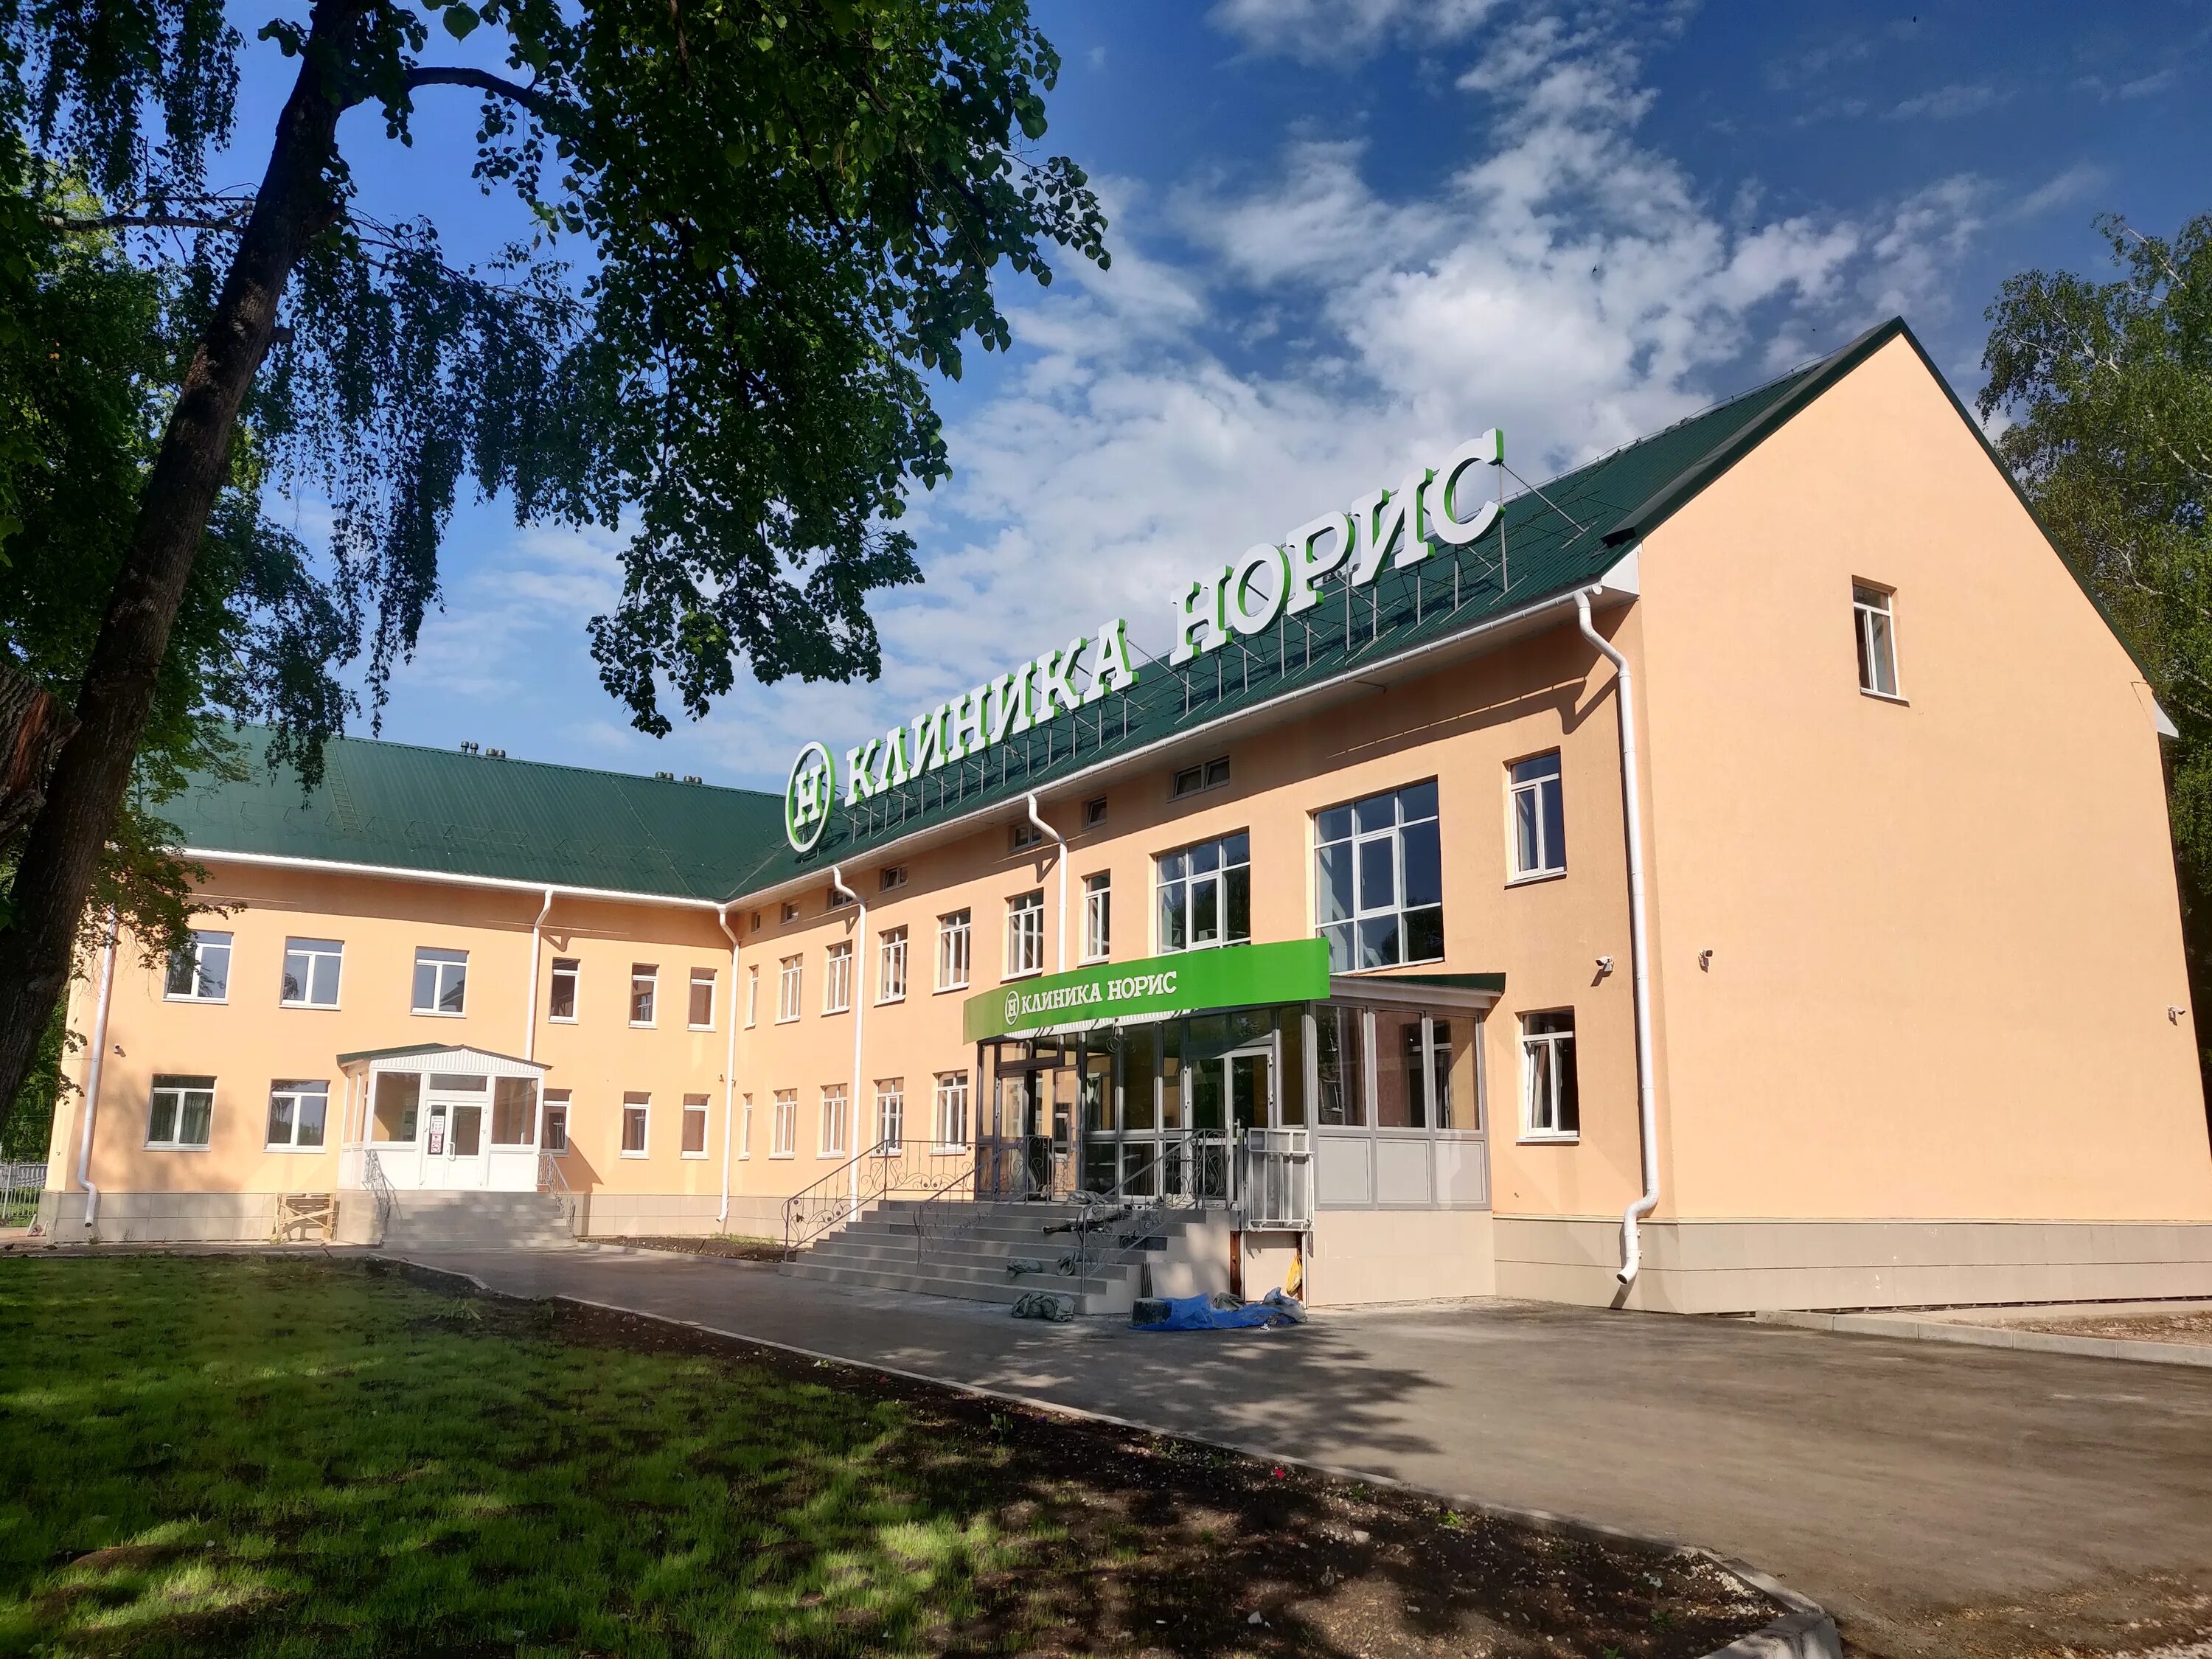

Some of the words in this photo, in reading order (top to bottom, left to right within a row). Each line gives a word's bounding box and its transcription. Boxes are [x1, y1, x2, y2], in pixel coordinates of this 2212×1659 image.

[844, 618, 1139, 807] КЛИНИКА
[1169, 428, 1504, 666] НОРИС
[1020, 983, 1103, 1015] КЛИНИКА
[1107, 971, 1177, 1001] НОРИС
